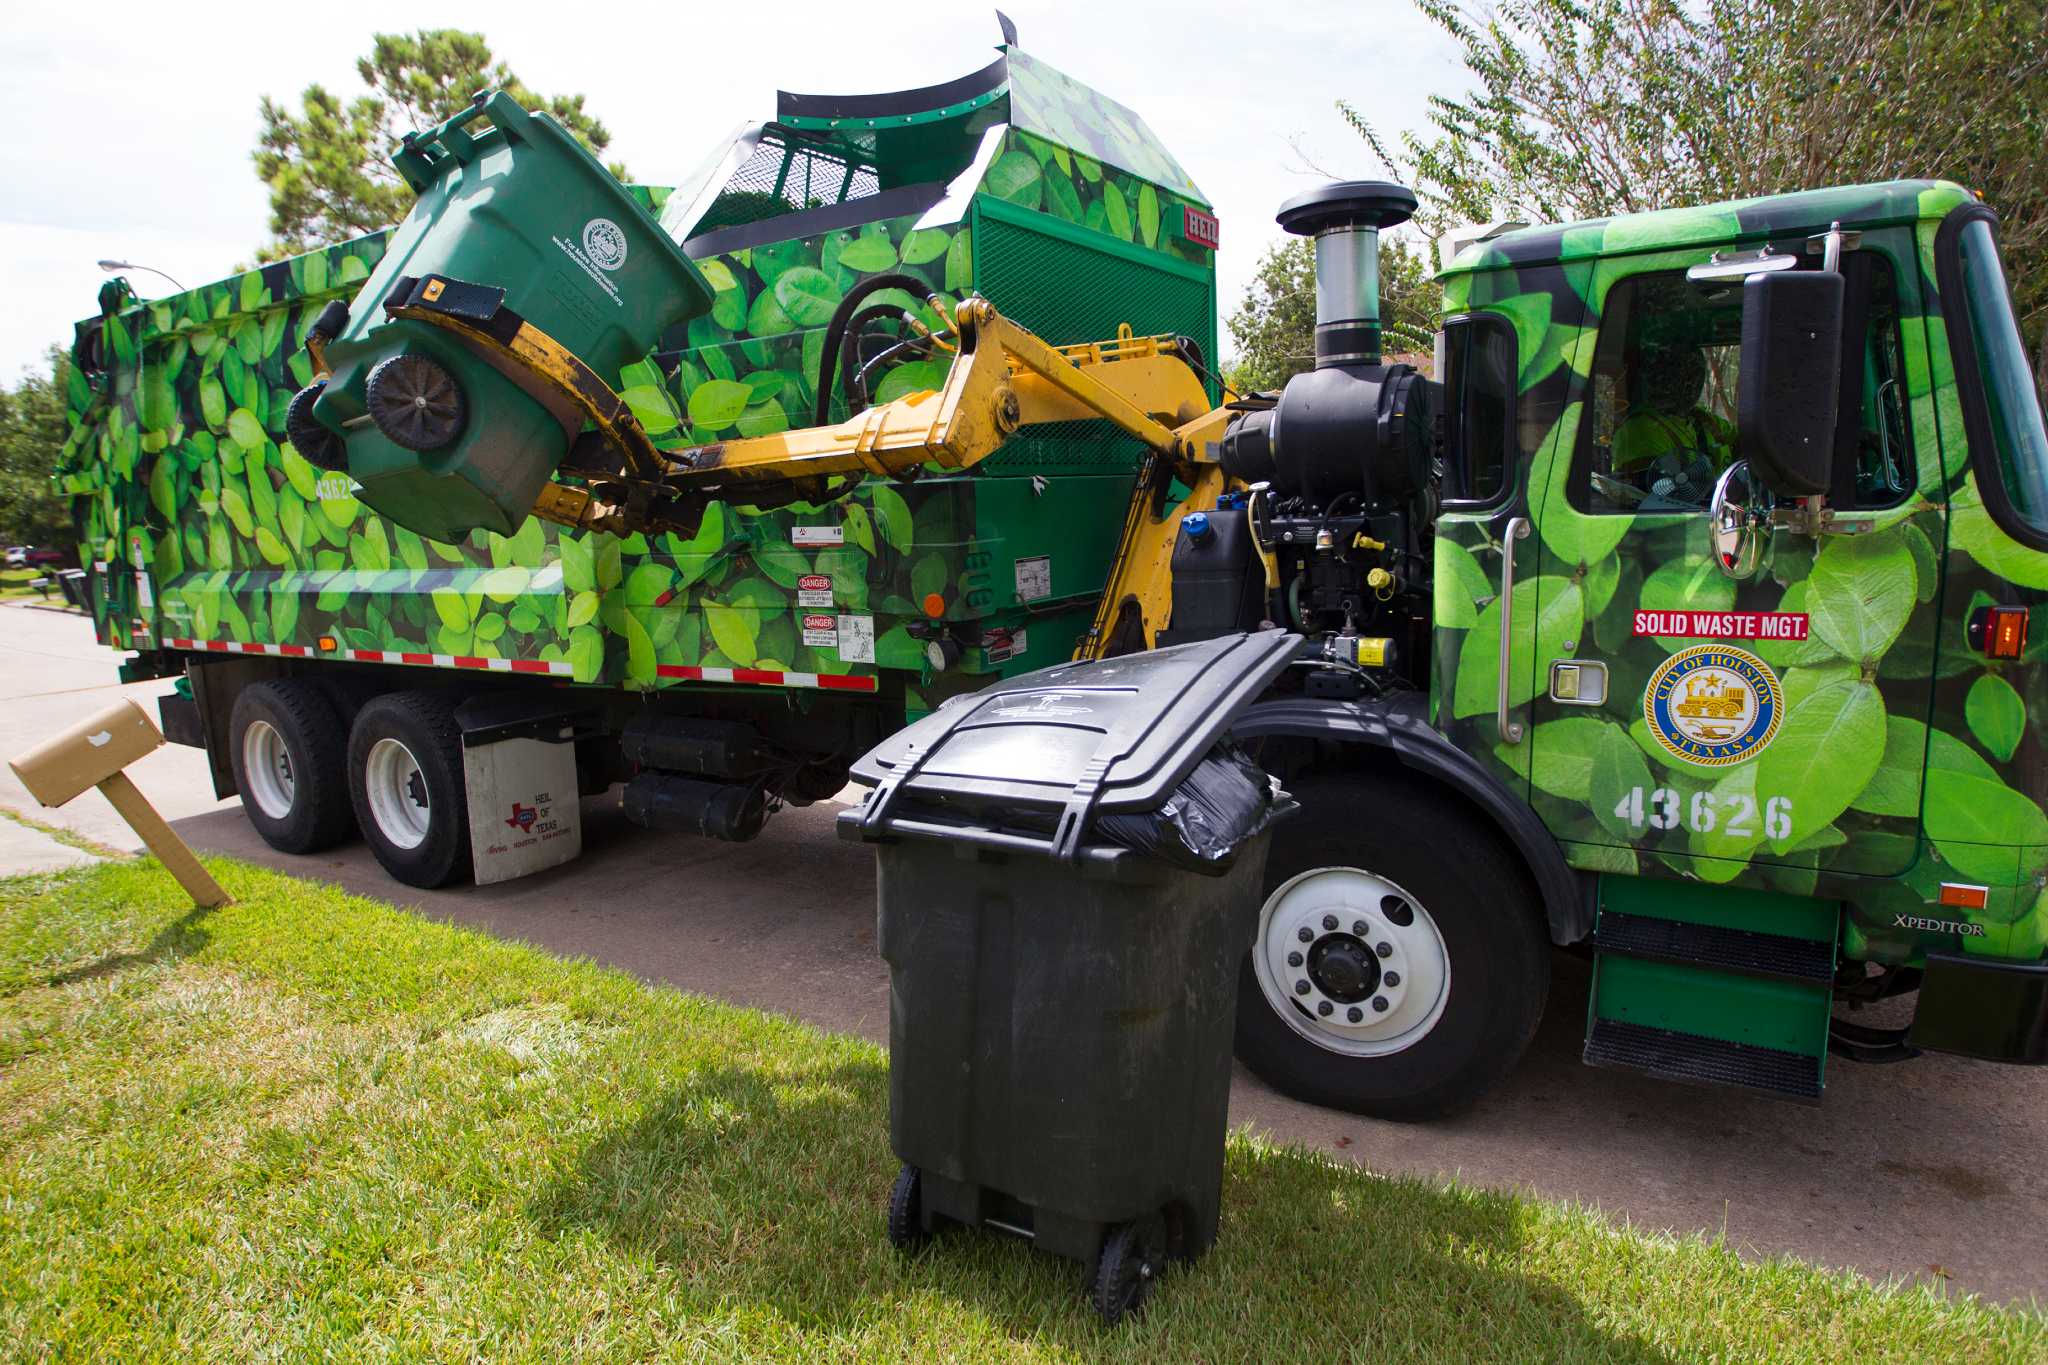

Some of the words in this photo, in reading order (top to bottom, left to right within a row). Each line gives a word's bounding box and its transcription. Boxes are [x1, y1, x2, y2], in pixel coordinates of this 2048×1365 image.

[1188, 211, 1219, 244] HEIL
[564, 238, 576, 250] For
[575, 248, 590, 264] More
[316, 479, 353, 500] 4362
[801, 578, 829, 588] DANGER
[806, 618, 833, 628] DANGER
[1635, 613, 1688, 634] SOLID
[1693, 614, 1756, 636] WASTE
[1761, 616, 1807, 638] MGT.
[1657, 667, 1680, 700] CITY
[1683, 656, 1705, 671] OF
[1710, 655, 1772, 705] HOUSTON
[1678, 738, 1743, 757] TEXAS
[535, 792, 552, 804] HEIL
[540, 806, 551, 818] OF
[1613, 786, 1792, 840] 43626
[536, 820, 557, 833] TEXAS
[1891, 913, 1984, 936] XPEDITOR
